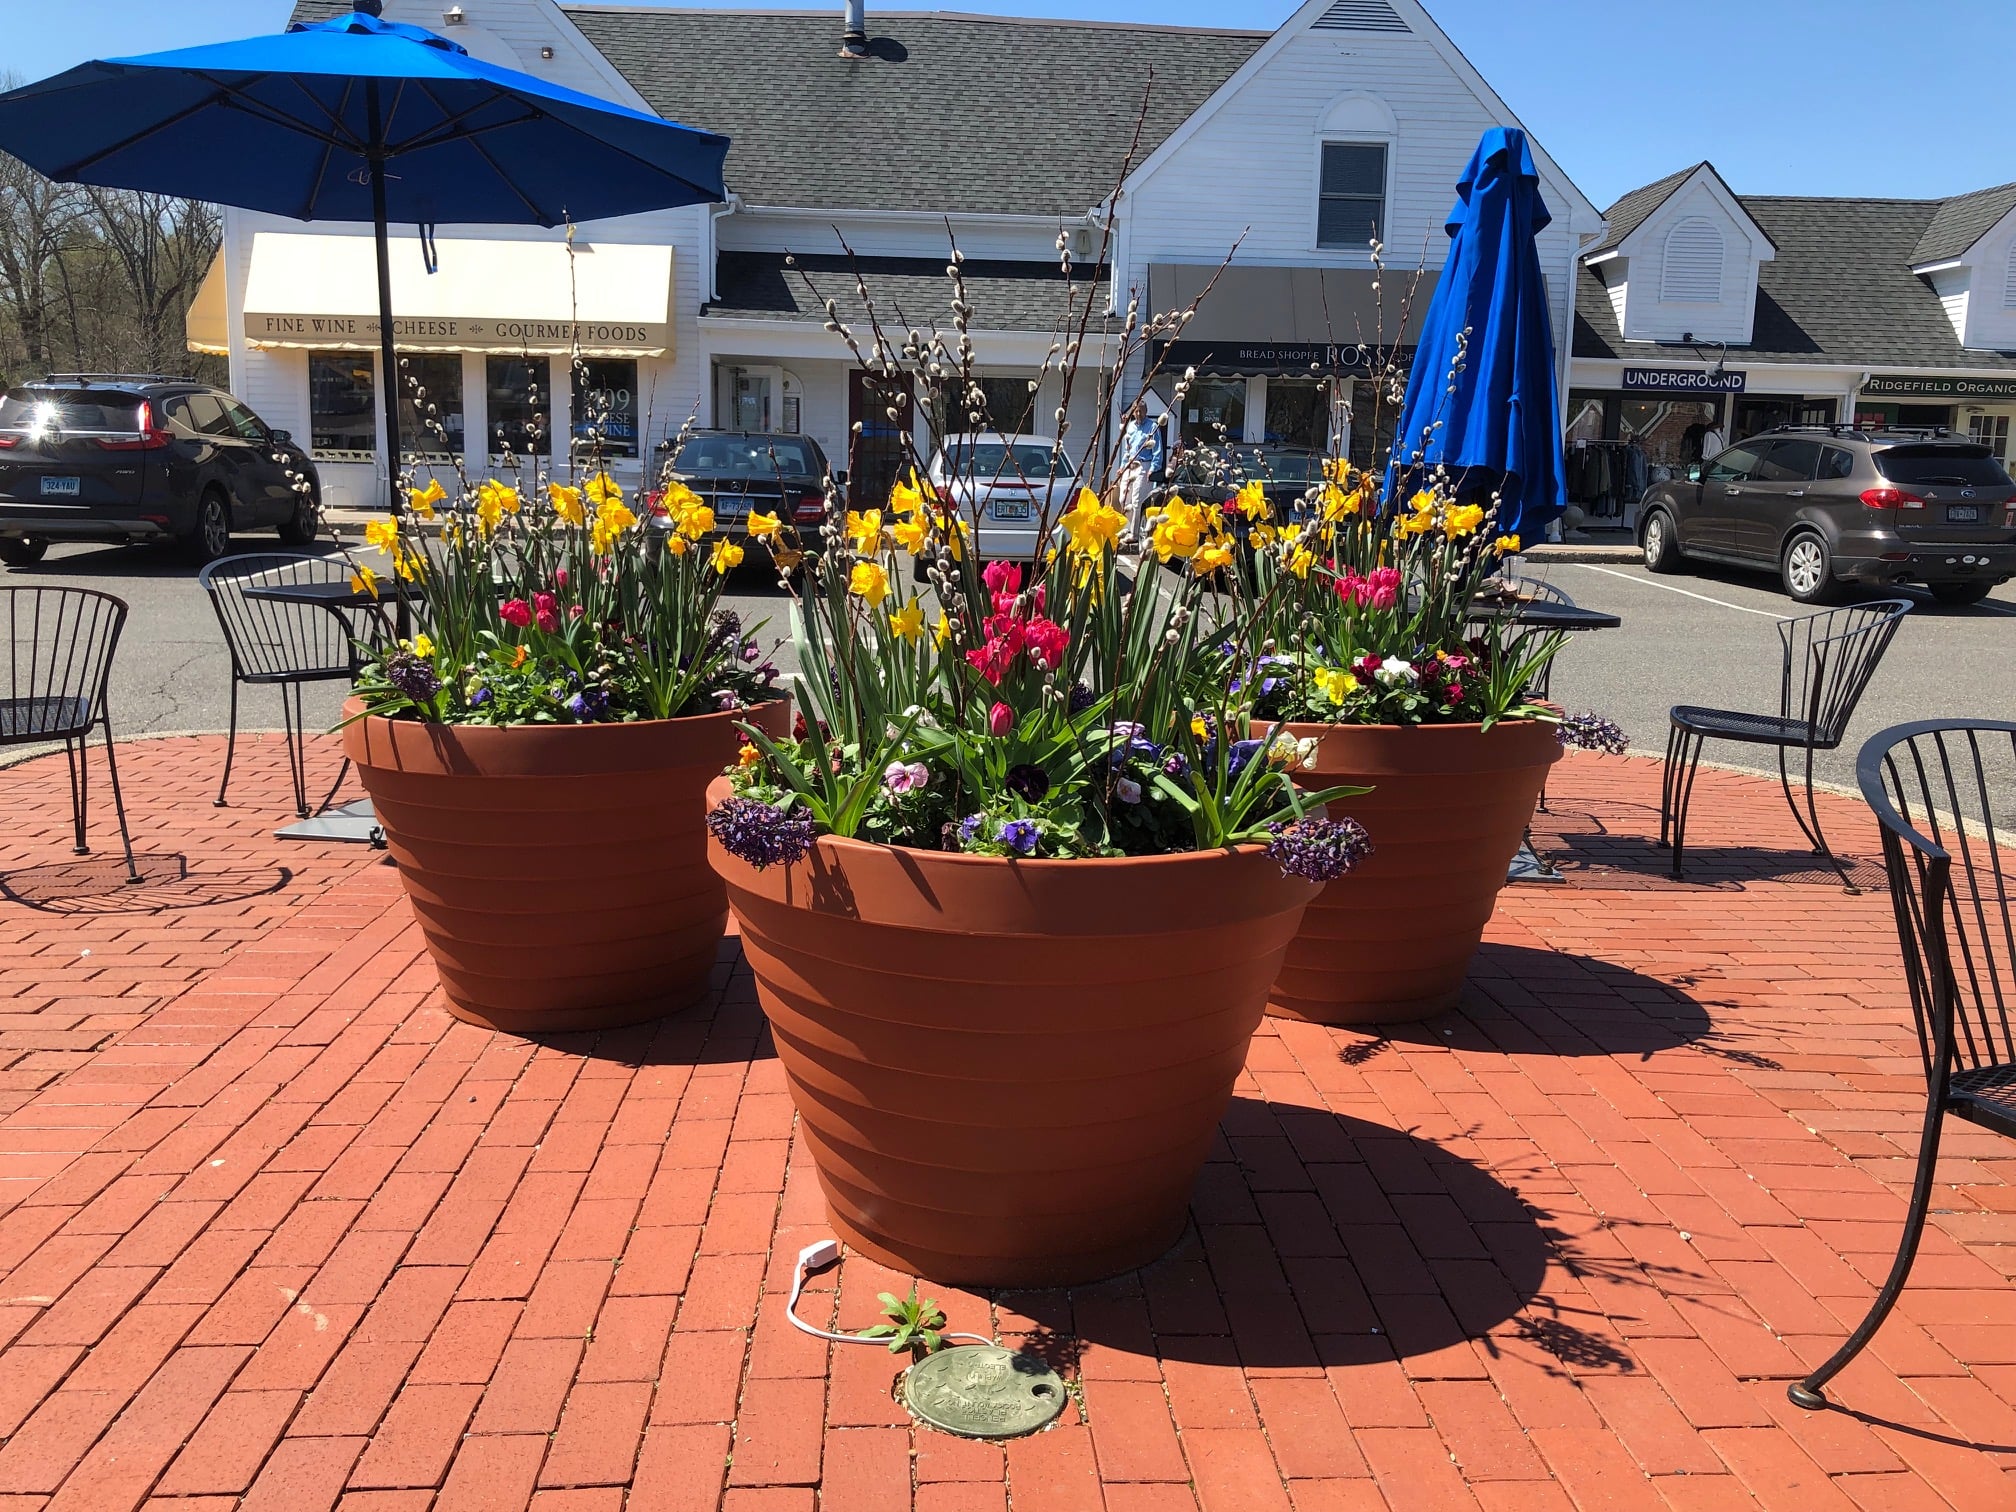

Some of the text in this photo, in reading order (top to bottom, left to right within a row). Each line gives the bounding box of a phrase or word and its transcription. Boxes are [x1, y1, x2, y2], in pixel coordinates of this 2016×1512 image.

[266, 317, 304, 332] FINE
[312, 318, 356, 334] WINE
[392, 320, 457, 336] CHEESE
[588, 326, 647, 342] FOODS
[1239, 350, 1276, 359] BREAD
[1325, 345, 1385, 366] ROSS
[1626, 371, 1742, 388] UNDERGROUND
[1869, 379, 2016, 394] RIDGEFIELD ORGANIC
